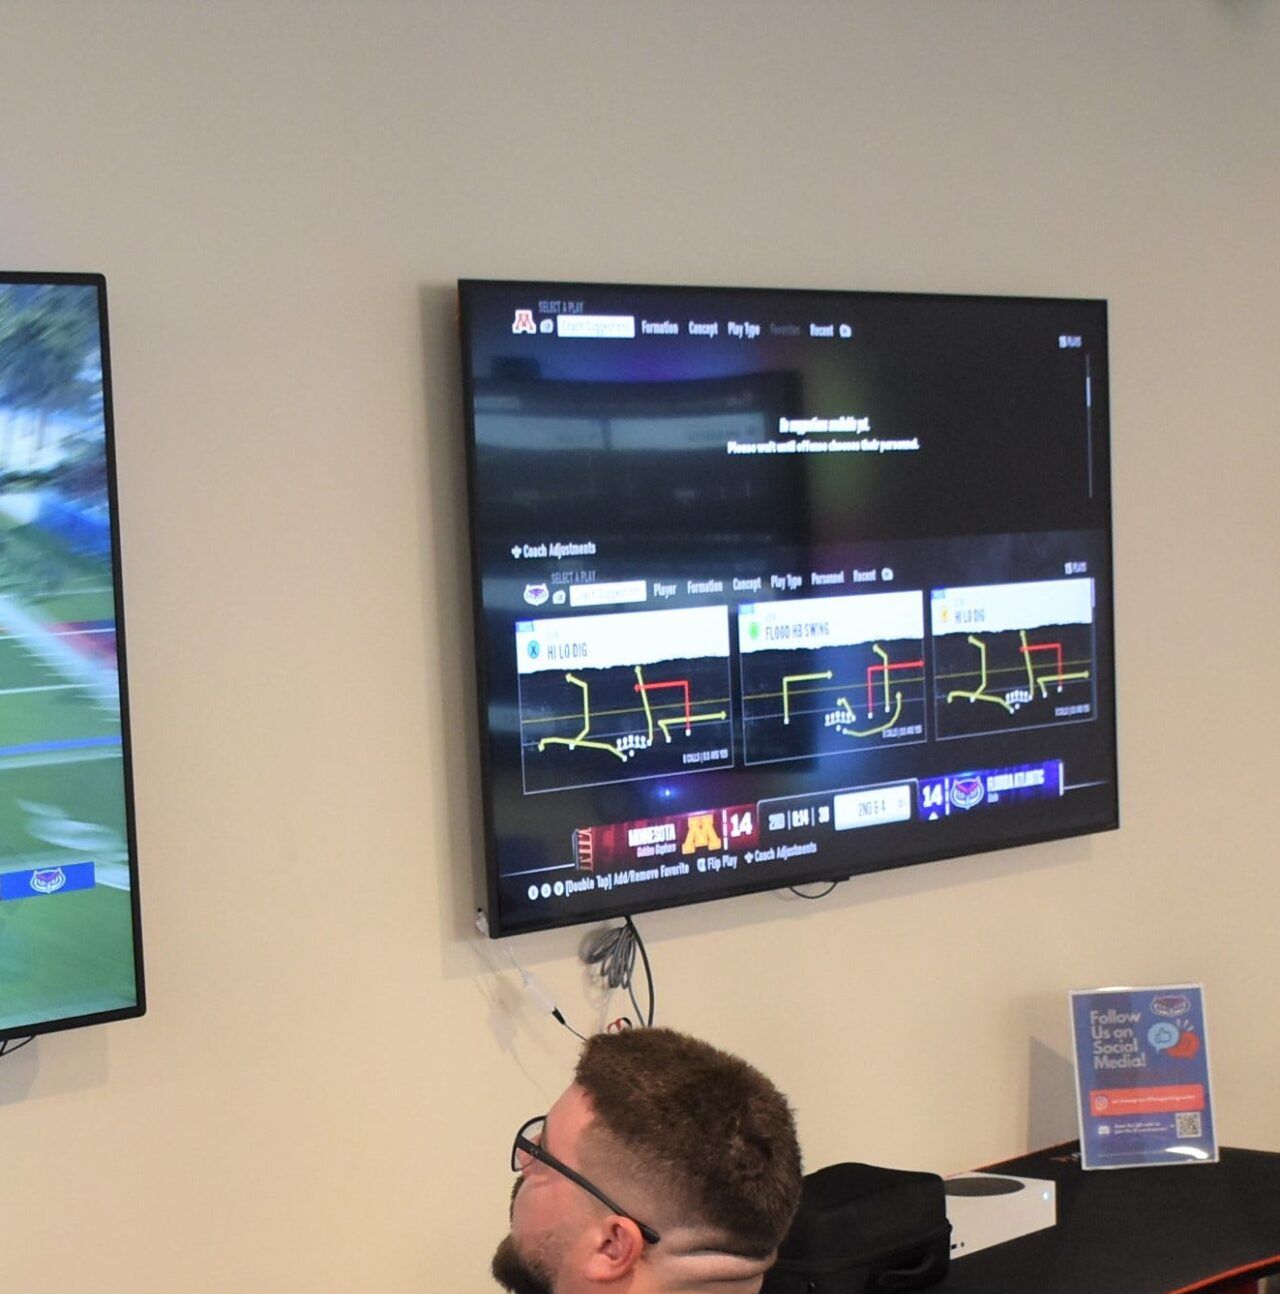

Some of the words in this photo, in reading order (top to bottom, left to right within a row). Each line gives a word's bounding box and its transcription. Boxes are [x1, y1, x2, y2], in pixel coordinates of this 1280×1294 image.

[641, 319, 679, 335] Formation
[688, 320, 718, 338] Concept
[728, 321, 744, 340] Play
[744, 321, 761, 339] Type
[810, 323, 834, 337] Recent
[727, 440, 757, 454] Please
[523, 544, 548, 559] Coach
[548, 541, 597, 560] Adjustments
[551, 571, 573, 585] SELECT
[580, 570, 596, 583] PLAY
[653, 582, 677, 600] Player
[687, 578, 723, 595] Formation
[732, 576, 762, 593] Concept
[770, 574, 786, 592] Play
[786, 573, 803, 591] Type
[811, 570, 845, 586] Personnel
[853, 568, 877, 583] Recent
[765, 626, 791, 641] FLOOD
[792, 624, 804, 639] HB
[804, 621, 830, 638] SWING
[547, 645, 557, 661] HI
[559, 643, 571, 660] LO
[572, 642, 588, 659] DIG
[922, 783, 943, 808] 14
[857, 801, 872, 817] 2ND
[730, 811, 753, 838] 14
[565, 874, 595, 897] [Double
[596, 872, 613, 891] Tap]
[613, 866, 660, 887] Add/Remove
[660, 862, 690, 880] Favorite
[707, 856, 722, 872] Flip
[722, 854, 738, 871] Play
[754, 850, 776, 864] Coach
[776, 842, 818, 862] Adjustments
[1090, 1009, 1141, 1025] Follow
[1091, 1025, 1111, 1040] Us
[1113, 1028, 1134, 1039] on
[1093, 1038, 1139, 1055] Social
[1094, 1052, 1147, 1070] Media!
